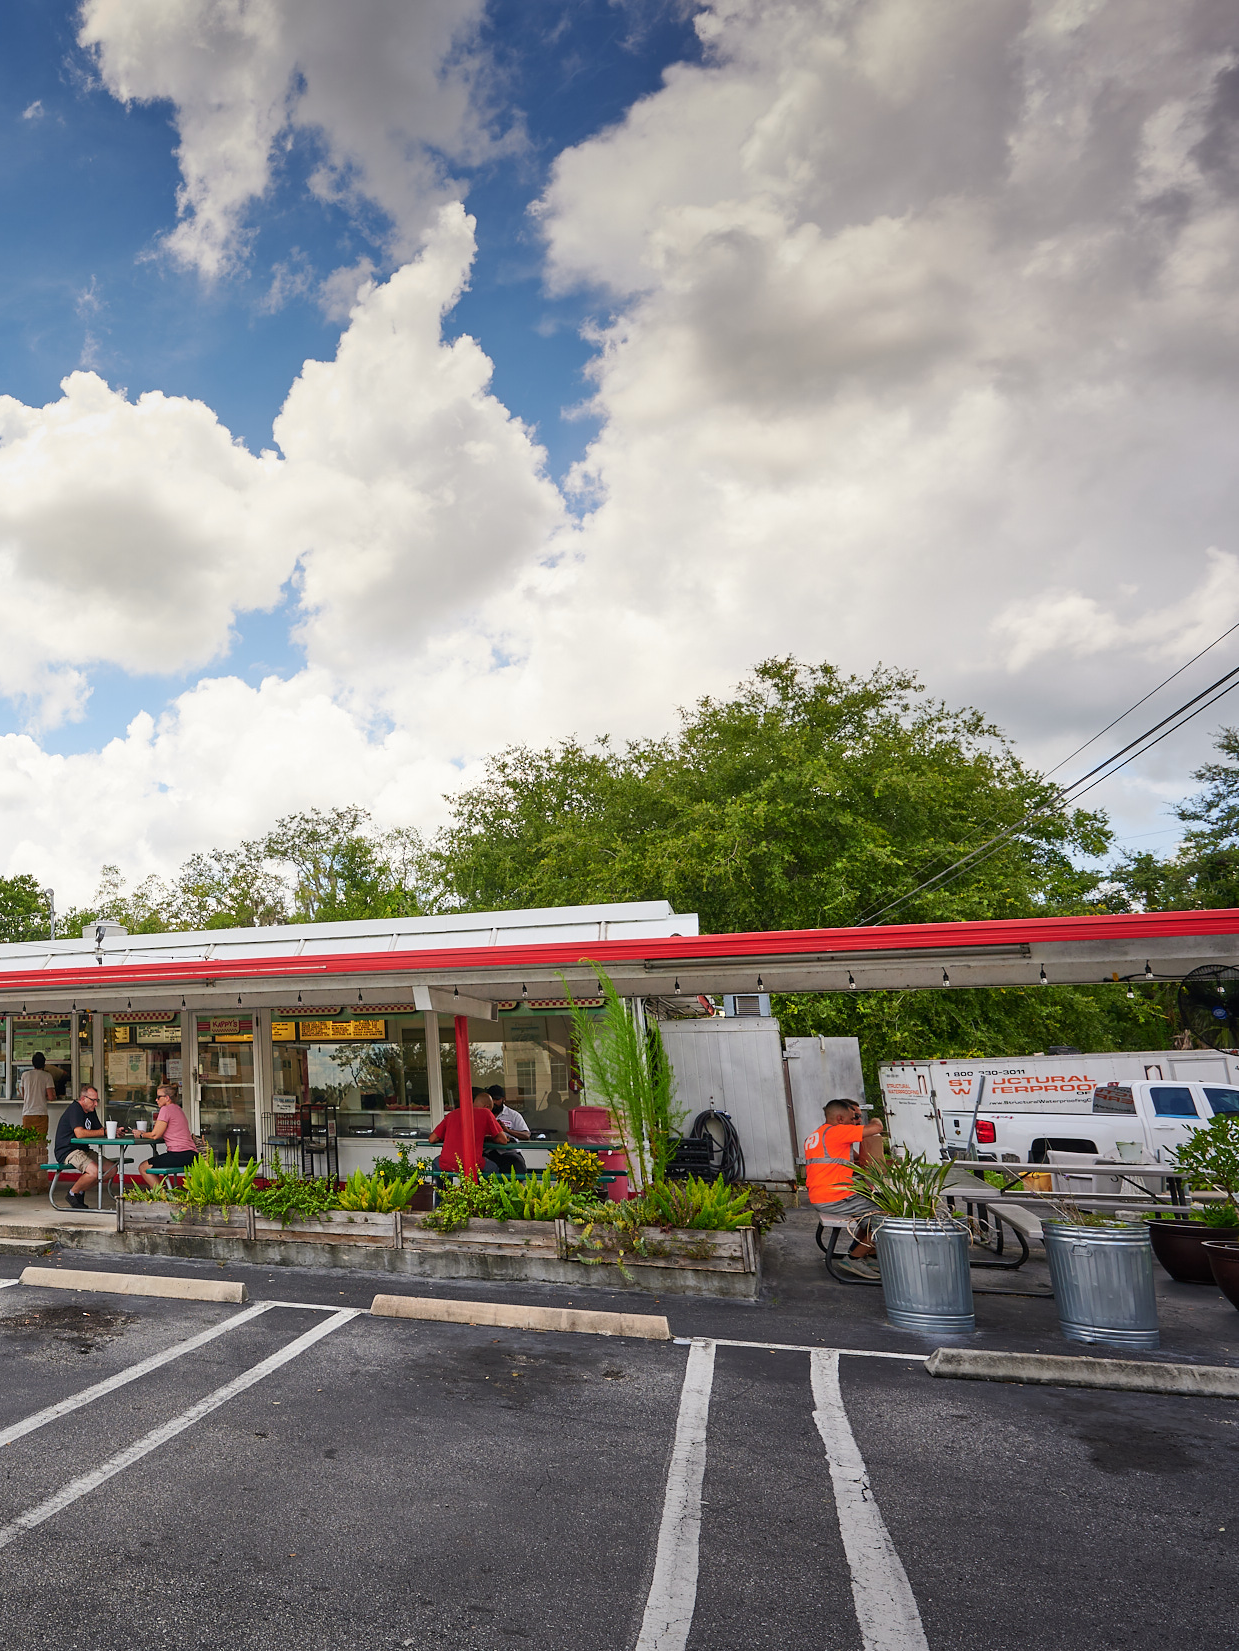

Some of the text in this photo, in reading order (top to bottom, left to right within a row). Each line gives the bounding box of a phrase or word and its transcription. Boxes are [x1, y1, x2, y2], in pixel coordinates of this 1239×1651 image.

[212, 1020, 238, 1028] KAPPY'S
[949, 1075, 1096, 1087] STUCTURAL
[950, 1084, 1098, 1095] WTERPROO
